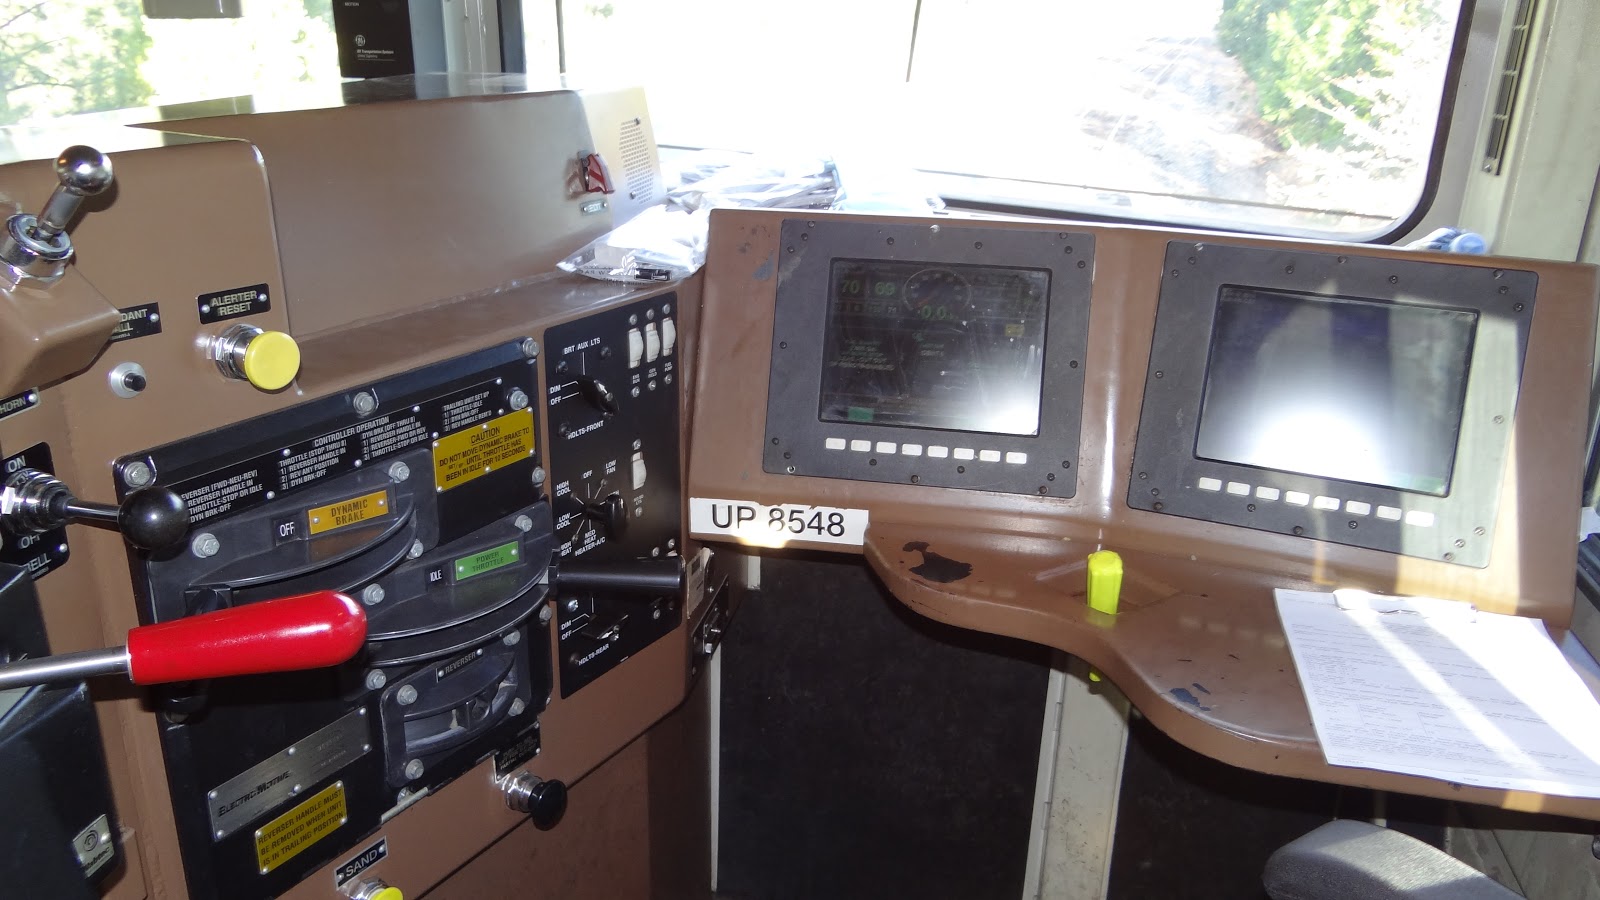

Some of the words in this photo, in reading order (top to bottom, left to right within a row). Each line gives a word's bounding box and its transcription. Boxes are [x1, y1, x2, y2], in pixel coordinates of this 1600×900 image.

[212, 290, 258, 307] ALERTER
[120, 308, 148, 322] DANT
[218, 302, 252, 316] RESET
[564, 345, 575, 355] BRT
[577, 341, 589, 350] AUX
[590, 337, 600, 346] LTS
[550, 384, 561, 394] DIM
[0, 396, 26, 414] HORN
[550, 396, 562, 406] OFF
[314, 428, 355, 447] CONTROLLER
[357, 416, 389, 433] OPERATION
[371, 430, 395, 444] REVERSER
[396, 424, 415, 435] HANDLE
[417, 426, 426, 434] REV
[418, 433, 429, 441] IDLE
[471, 426, 500, 443] CAUTION
[280, 453, 308, 467] THROTTLE
[326, 442, 340, 451] THRU
[440, 458, 448, 467] DO
[450, 452, 461, 463] NOT
[462, 448, 478, 458] MOVE
[480, 439, 503, 452] DYNAMIC
[504, 430, 522, 442] BRAKE
[522, 427, 529, 435] TO
[467, 455, 482, 464] UNTIL
[483, 443, 510, 458] THROTTLE
[511, 439, 521, 447] HAS
[8, 456, 26, 472] ON
[289, 458, 317, 472] REVERSER
[319, 451, 339, 462] HANDLE
[290, 471, 301, 479] REV
[302, 466, 313, 475] ANY
[315, 458, 339, 472] POSITION
[446, 470, 461, 481] BEEN
[470, 463, 482, 472] IDLE
[482, 458, 494, 467] FOR
[502, 445, 526, 460] SECONDS
[605, 460, 616, 468] LOW
[291, 477, 302, 487] DYN
[304, 469, 327, 482] BRK-OFF
[583, 470, 592, 478] OFF
[606, 466, 616, 475] FAN
[181, 486, 210, 500] EVERSER
[556, 480, 569, 490] HIGH
[557, 487, 571, 497] COOL
[188, 490, 220, 507] REVERSER
[222, 482, 245, 495] HANDLE
[189, 494, 238, 515] THROTTLE-STOP
[249, 484, 263, 494] IDLE
[190, 514, 204, 523] DYN
[205, 503, 231, 518] BRK-OFF
[331, 499, 368, 517] DYNAMIC
[336, 510, 364, 526] BRAKE
[557, 520, 571, 530] COOL
[559, 513, 570, 522] LOW
[712, 504, 756, 529] UP
[768, 508, 845, 537] 8548
[280, 522, 295, 536] OFF
[585, 530, 595, 539] MED
[575, 537, 606, 556] HEATER-A/C
[584, 535, 596, 545] HEAT
[472, 557, 504, 572] THROTTLE
[476, 551, 500, 562] POWER
[430, 570, 442, 582] IDLE
[561, 620, 572, 630] DIM
[561, 630, 572, 640] OFF
[445, 651, 476, 674] REVERSER
[578, 644, 609, 666] HDLTS-REAR
[258, 818, 294, 845] REVERSER
[296, 803, 322, 823] HANDLE
[323, 789, 342, 806] MUST
[261, 847, 270, 856] BE
[272, 824, 305, 849] REMOVED
[306, 812, 325, 828] WHEN
[327, 801, 342, 816] UNIT
[263, 858, 270, 866] IS
[272, 852, 280, 862] IN
[282, 833, 312, 856] TRAILING
[314, 811, 344, 835] POSITION
[346, 850, 377, 876] SAND
